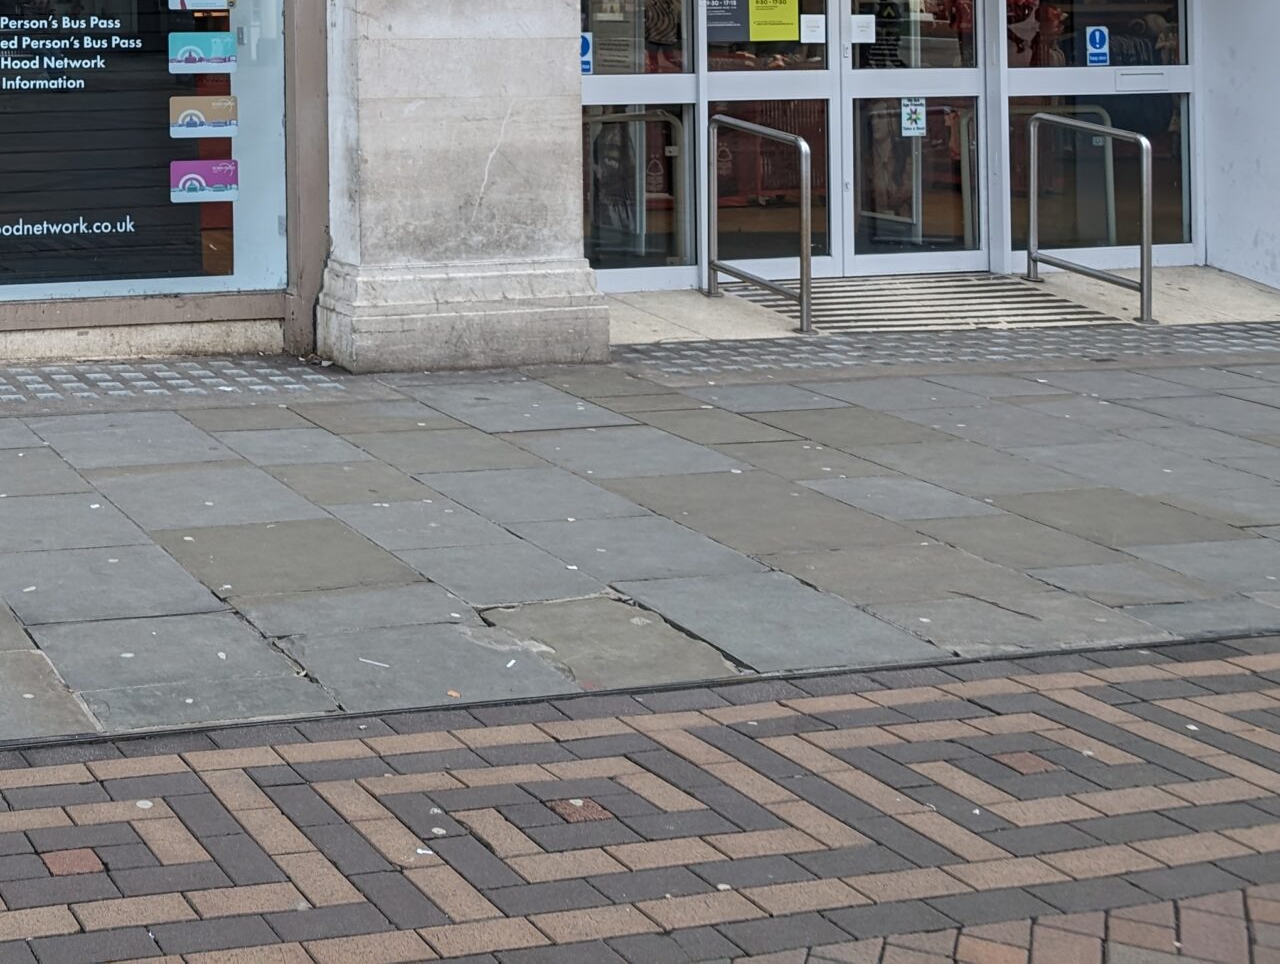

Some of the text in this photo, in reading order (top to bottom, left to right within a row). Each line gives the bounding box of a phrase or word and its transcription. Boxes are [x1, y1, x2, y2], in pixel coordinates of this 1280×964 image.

[0, 15, 58, 29] Person's
[62, 16, 87, 29] Bus
[90, 16, 121, 29] Pass
[22, 36, 79, 49] Person's
[83, 36, 108, 49] Bus
[111, 36, 142, 48] Pass
[0, 55, 39, 69] Hood
[43, 55, 106, 69] Network
[2, 75, 85, 90] Information
